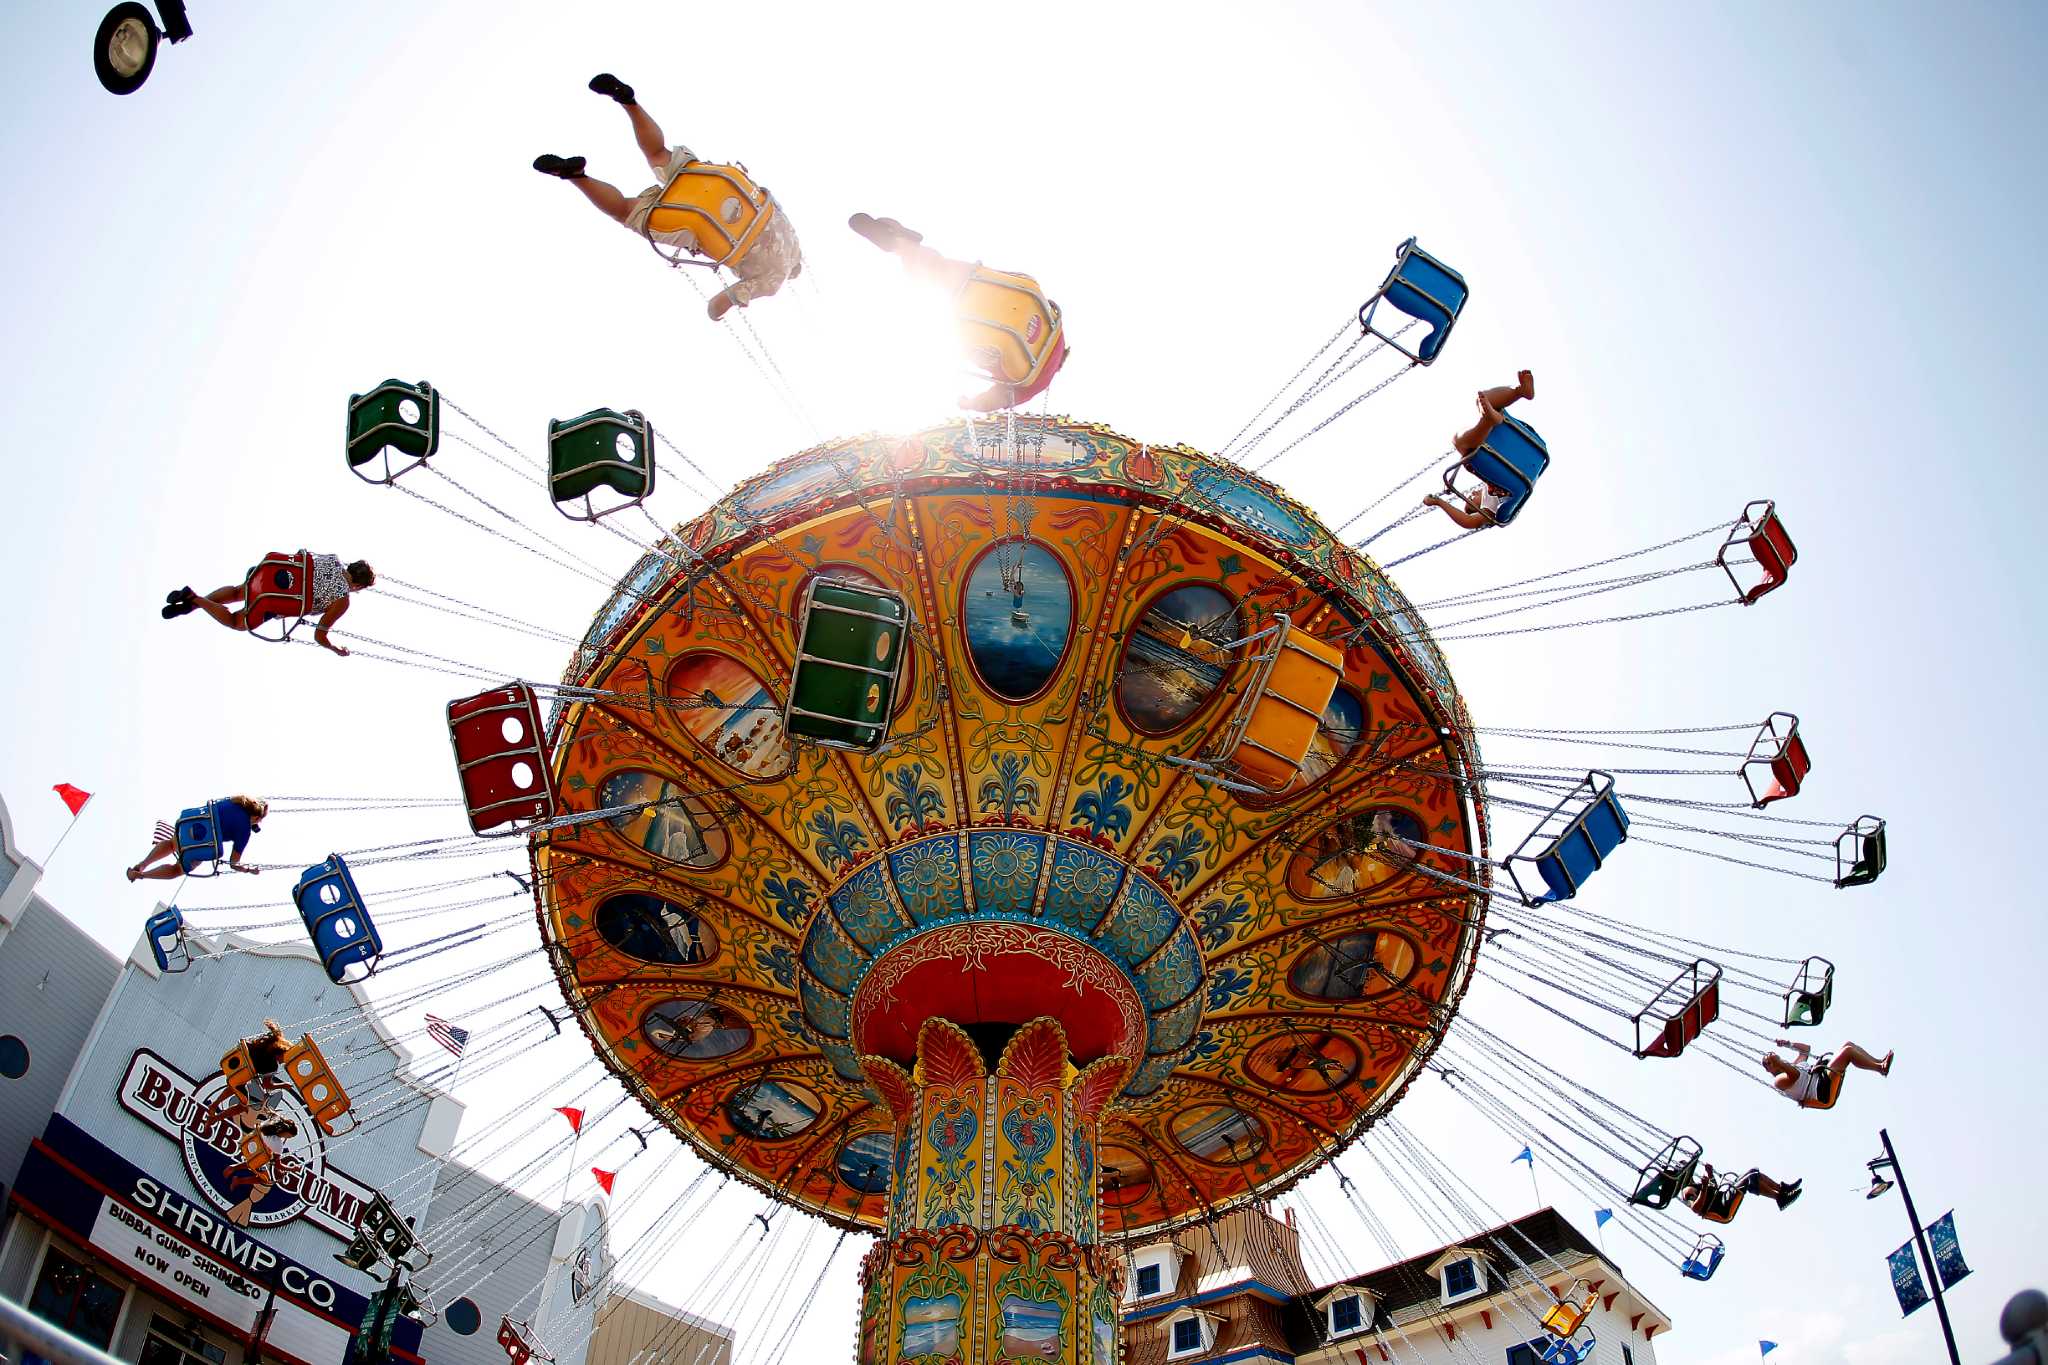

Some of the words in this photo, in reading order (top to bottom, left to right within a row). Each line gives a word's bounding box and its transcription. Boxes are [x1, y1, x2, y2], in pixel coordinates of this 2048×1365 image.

[535, 802, 543, 815] 55
[132, 1064, 246, 1159] BUBB
[185, 1138, 226, 1206] RESTAURANT
[253, 1214, 261, 1222] &
[265, 1202, 303, 1222] MARKET
[109, 1203, 153, 1240] BUBBA
[156, 1232, 191, 1259] GUMP
[131, 1177, 277, 1271] SHRIMP
[281, 1265, 336, 1312] CO.
[134, 1245, 170, 1274] NOW
[173, 1270, 211, 1299] OPEN
